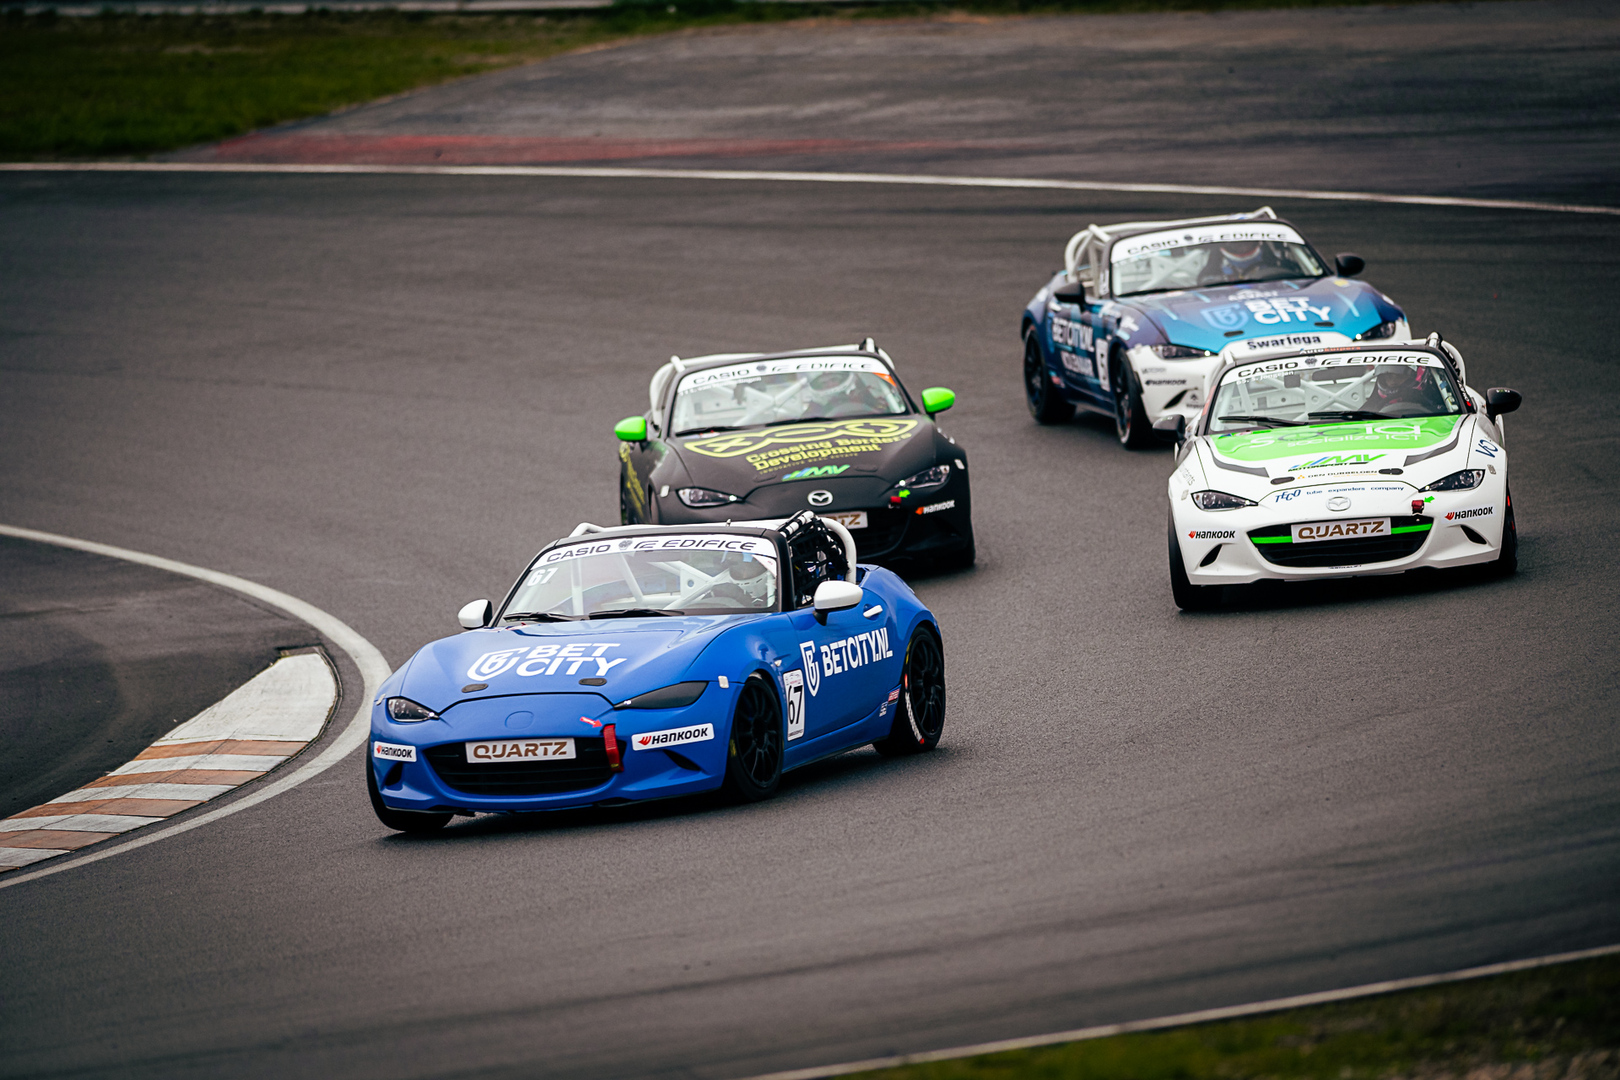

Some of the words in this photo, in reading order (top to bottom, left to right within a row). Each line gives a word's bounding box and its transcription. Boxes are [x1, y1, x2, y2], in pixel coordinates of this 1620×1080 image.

[1128, 239, 1178, 255] CASIO
[1220, 232, 1287, 241] EDIFICE
[1245, 297, 1309, 312] BET
[1254, 306, 1331, 324] CITY
[693, 369, 749, 384] CASIO
[796, 362, 871, 371] EDIFICE
[1238, 361, 1299, 378] CASIO
[1347, 355, 1430, 365] EDIFICE
[746, 441, 832, 463] Crossing
[835, 433, 912, 446] Borders
[752, 444, 882, 470] Development
[1298, 521, 1385, 540] QUARTZ
[546, 544, 611, 562] CASIO
[661, 539, 757, 551] EDIFICE
[526, 567, 559, 587] 67
[526, 643, 621, 659] BET
[820, 627, 893, 677] BETCITY.NL
[516, 657, 628, 677] CITY
[788, 685, 804, 725] 67
[473, 741, 567, 760] QUARTZ
